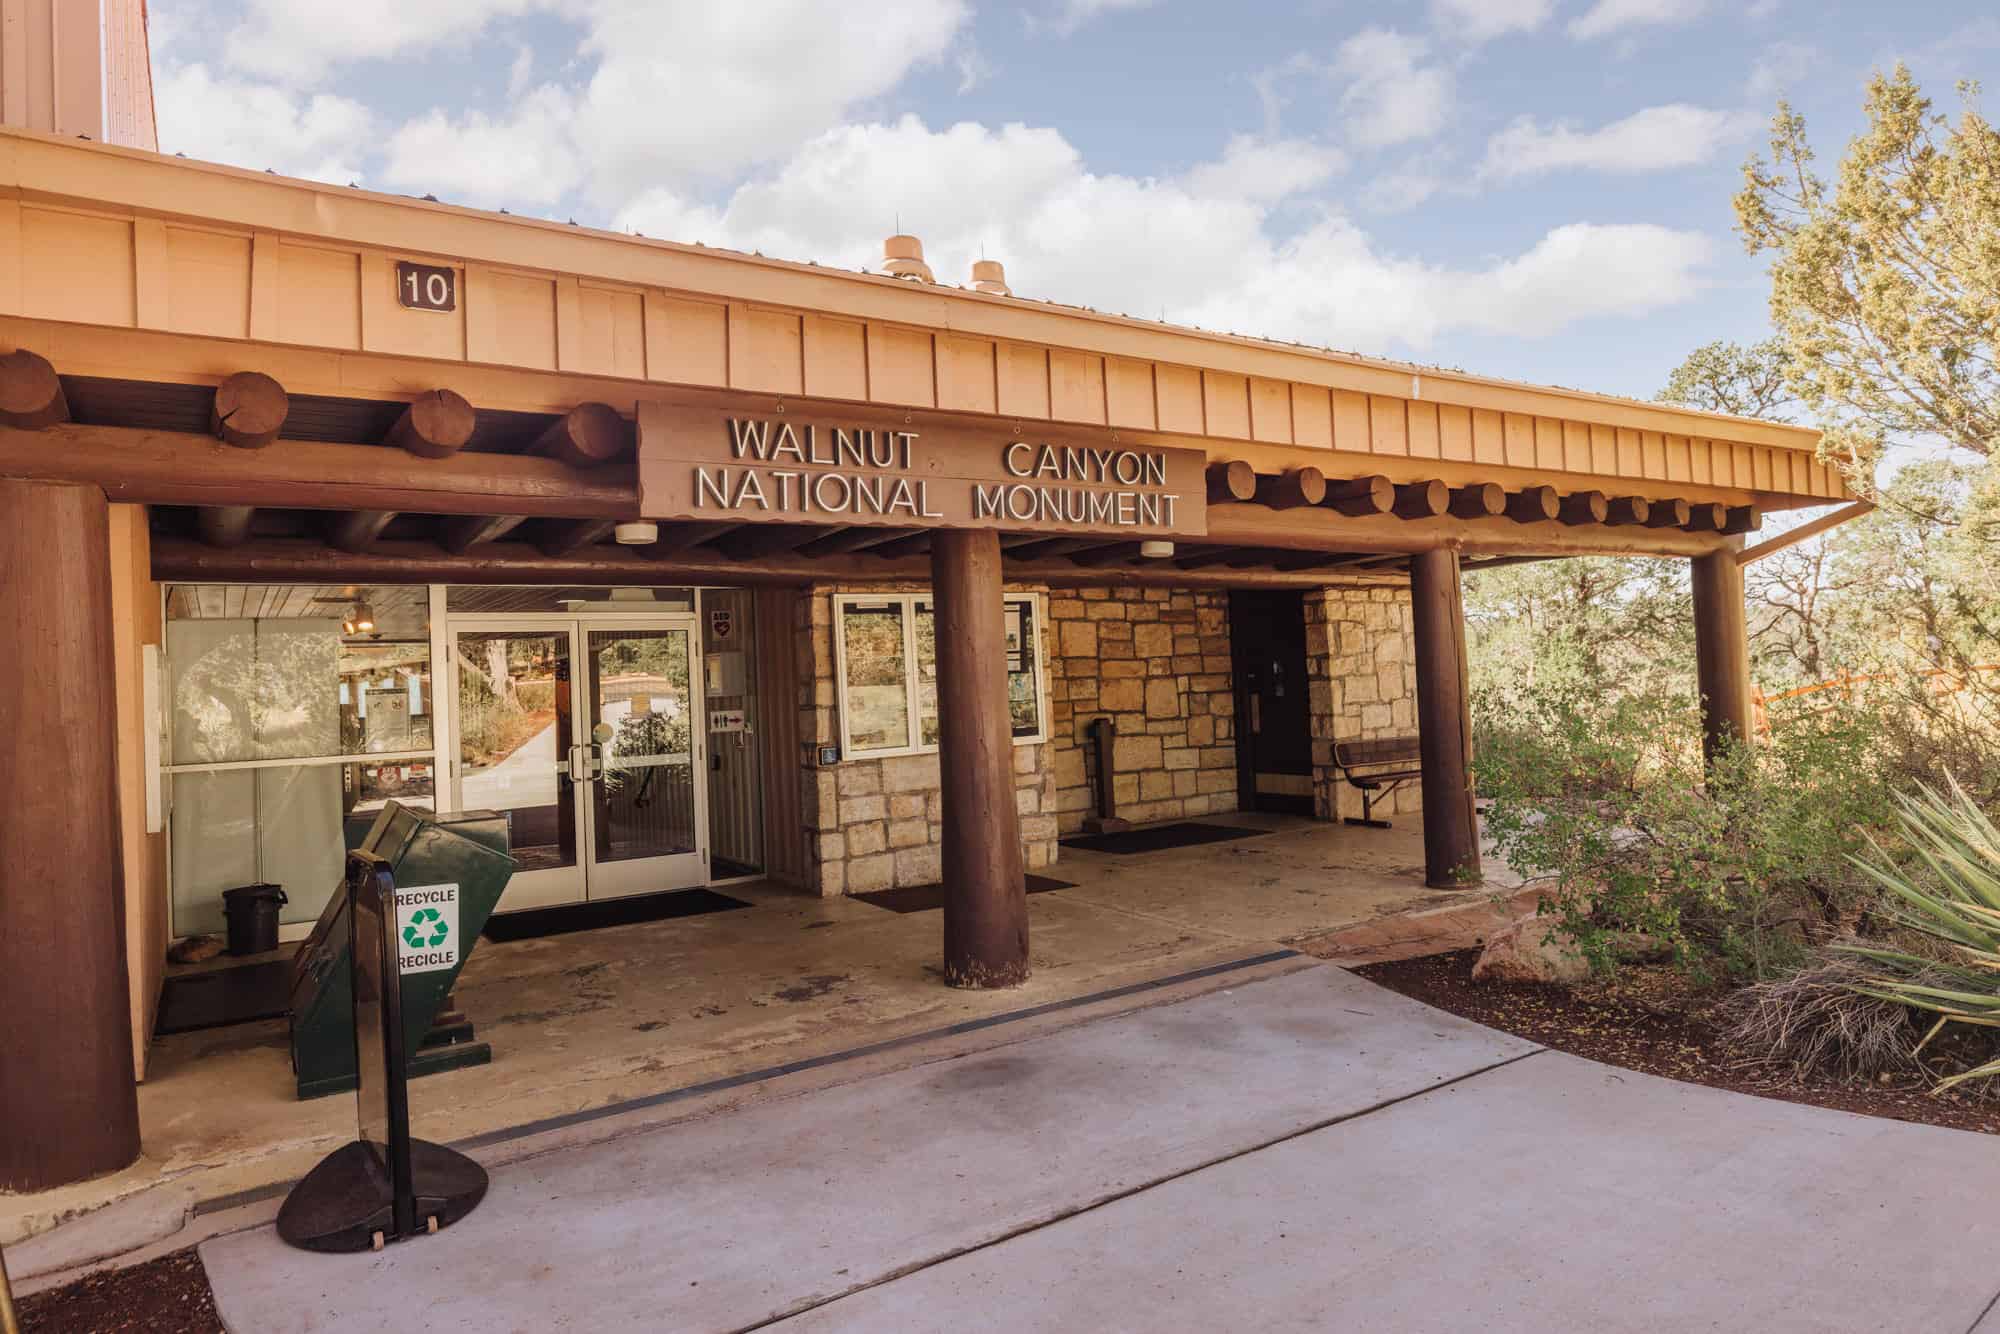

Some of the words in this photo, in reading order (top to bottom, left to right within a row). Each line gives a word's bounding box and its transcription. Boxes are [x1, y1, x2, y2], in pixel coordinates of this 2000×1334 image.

[407, 271, 448, 305] 10
[730, 418, 919, 469] WALNUT
[1006, 442, 1166, 486] CANYON
[695, 467, 943, 518] NATIONAL
[975, 483, 1180, 528] MONUMENT
[396, 889, 455, 907] RECYCLE
[399, 951, 454, 969] RECICLE
